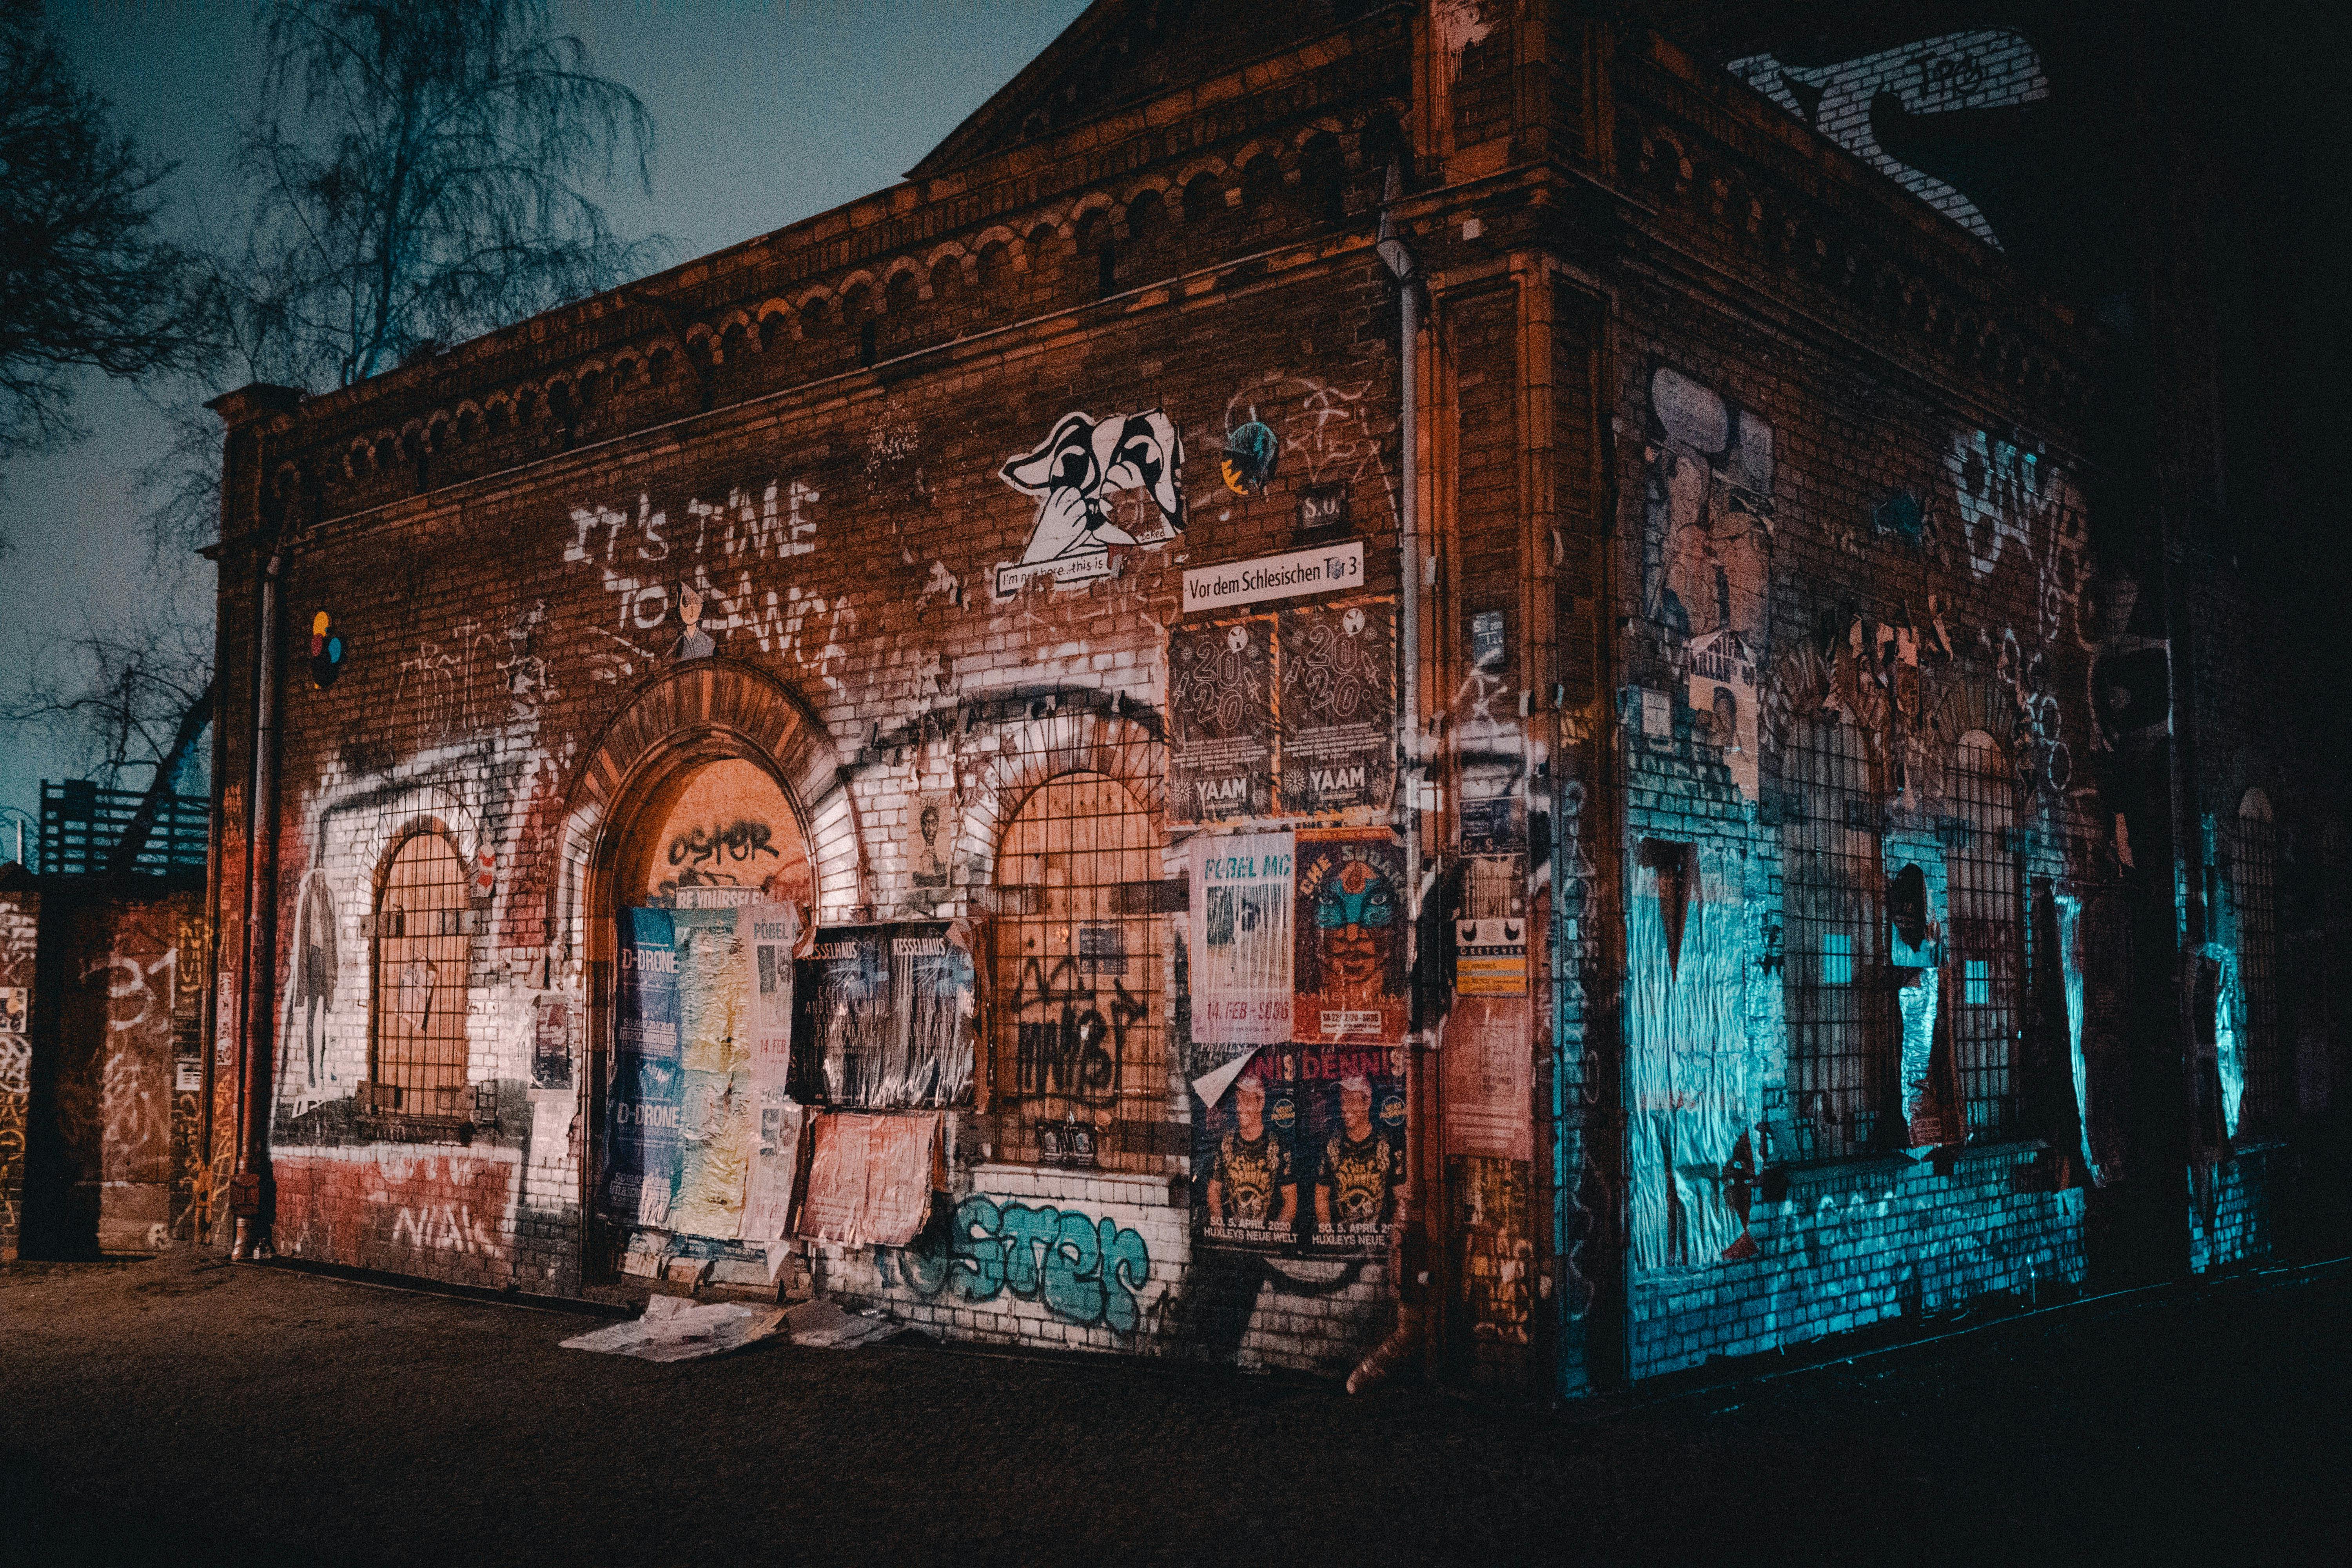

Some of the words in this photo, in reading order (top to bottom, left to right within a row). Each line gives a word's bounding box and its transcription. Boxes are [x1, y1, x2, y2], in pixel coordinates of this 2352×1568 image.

[1189, 579, 1211, 599] Vor
[1213, 572, 1240, 595] dem
[1242, 561, 1320, 591] Schlesischen
[1323, 557, 1346, 580] Tr
[1348, 556, 1357, 575] 3
[604, 568, 669, 629] TO
[1196, 777, 1247, 801] YAAM
[1310, 767, 1365, 791] YAAM
[1263, 854, 1291, 876] MC
[803, 941, 858, 960] SSELHAUS
[893, 937, 946, 956] KESSELHAUS
[622, 948, 679, 974] D-DRONE
[1225, 1002, 1247, 1020] FEB
[1302, 1049, 1404, 1080] DENNIS
[616, 1102, 681, 1128] D-DRONE
[1210, 1216, 1225, 1227] SO.
[1239, 1218, 1266, 1230] APRIL
[1269, 1220, 1292, 1231] 2020
[1350, 1222, 1377, 1232] APRIL
[1203, 1226, 1245, 1240] HUXLEYS
[1247, 1229, 1272, 1241] NEUE
[1274, 1232, 1298, 1244] WELT
[1312, 1234, 1356, 1246] HUXLEYS
[1359, 1234, 1386, 1245] NEUE
